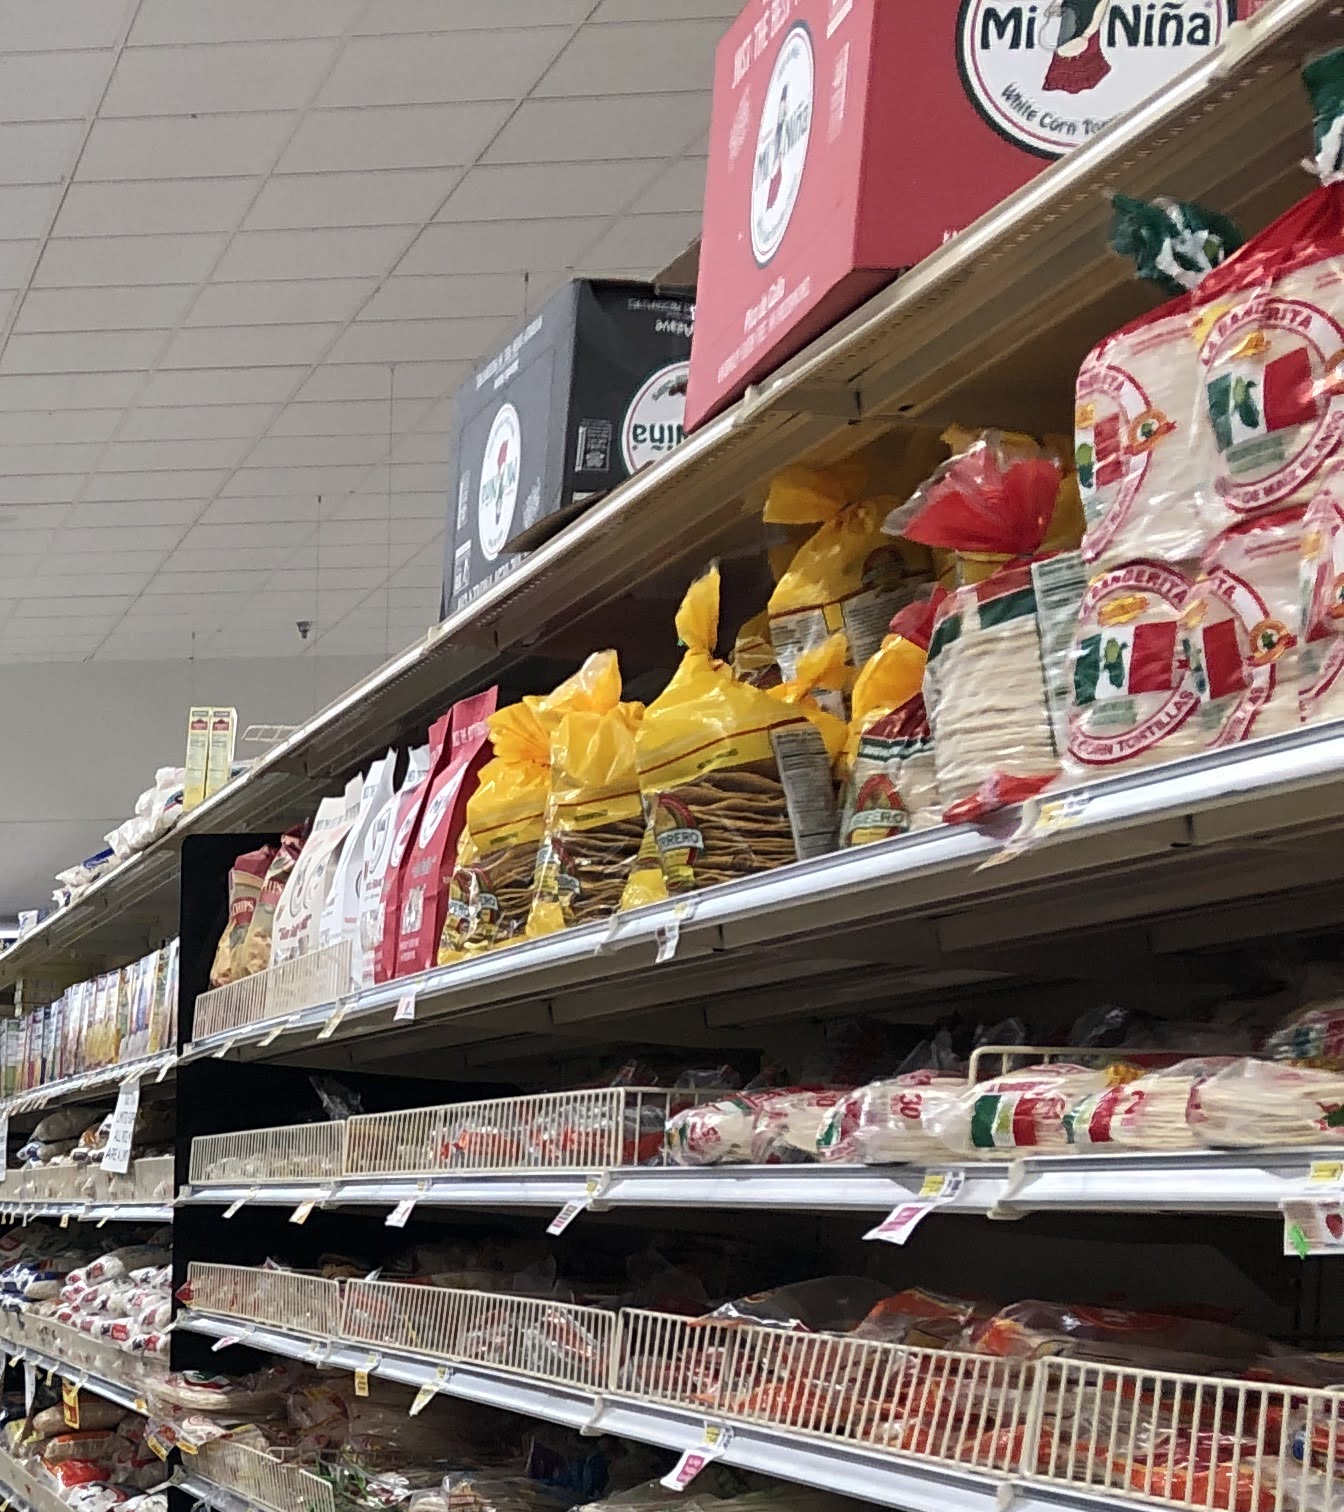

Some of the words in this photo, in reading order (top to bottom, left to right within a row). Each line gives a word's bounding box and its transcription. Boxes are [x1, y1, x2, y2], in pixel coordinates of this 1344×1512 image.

[981, 6, 1037, 51] Mi
[1106, 0, 1211, 49] Niña
[1001, 81, 1038, 123] White
[1039, 113, 1078, 137] Corn
